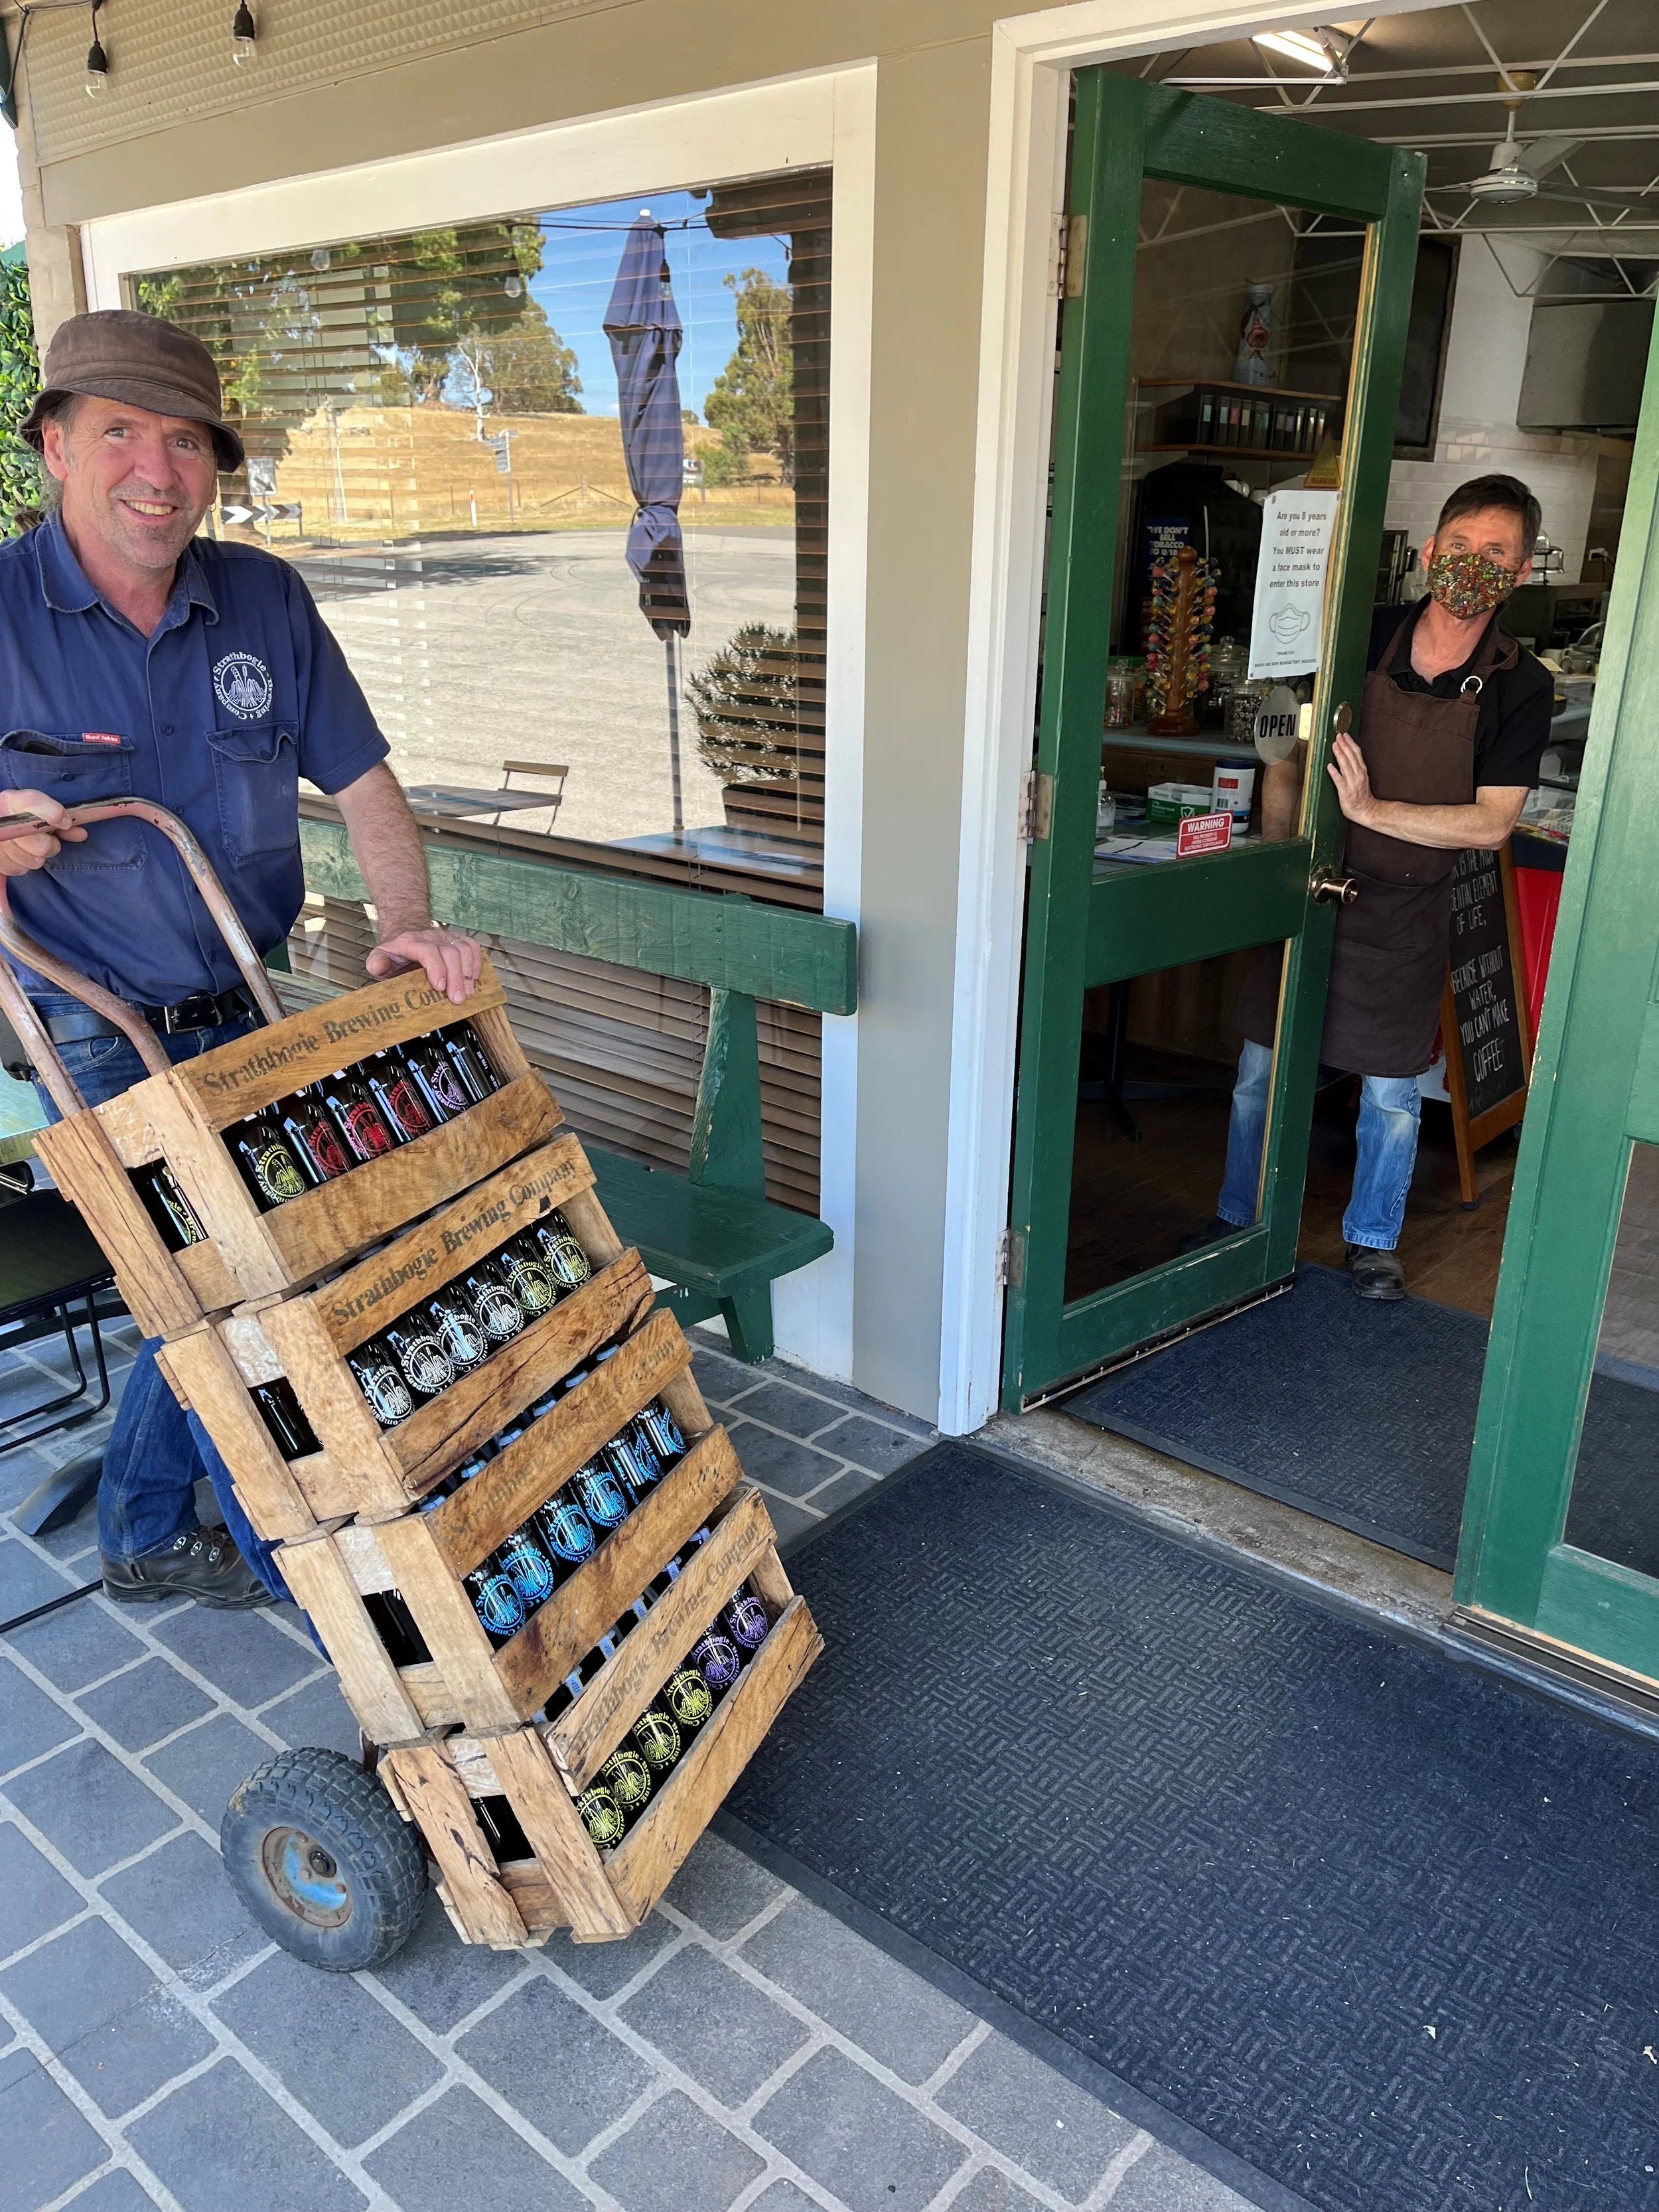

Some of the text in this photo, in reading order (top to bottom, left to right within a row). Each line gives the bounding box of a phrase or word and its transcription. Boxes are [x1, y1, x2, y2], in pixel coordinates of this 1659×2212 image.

[1277, 511, 1327, 523] Are you 8 years
[1279, 528, 1289, 537] old
[1298, 528, 1321, 537] more?
[1273, 546, 1284, 555] You
[1285, 546, 1305, 555] MUST
[1277, 562, 1291, 571] face
[1292, 563, 1311, 571] mask
[1313, 563, 1321, 571] to
[1286, 579, 1299, 587] this
[212, 651, 267, 676] Strathbogie
[214, 682, 248, 720] Company
[1260, 713, 1297, 738] OPEN
[1187, 818, 1225, 833] WARNING
[1457, 905, 1486, 935] OF LIFE,
[1451, 944, 1504, 994] BECAUSE WITHOUT
[1469, 980, 1496, 1011] WATER,
[1459, 998, 1510, 1047] YOU CAN'T MAKE
[203, 1035, 321, 1097] Strathbogie
[322, 999, 405, 1043] Brewing
[1473, 1037, 1504, 1082] COFFEE
[332, 1157, 579, 1327] Strathbogie Brewing Company
[405, 1373, 443, 1394] Company
[586, 1507, 618, 1528] Company
[551, 1541, 585, 1562] Company
[541, 1559, 554, 1600] Brewing
[479, 1615, 516, 1636] Company
[670, 1722, 682, 1763] Brewing
